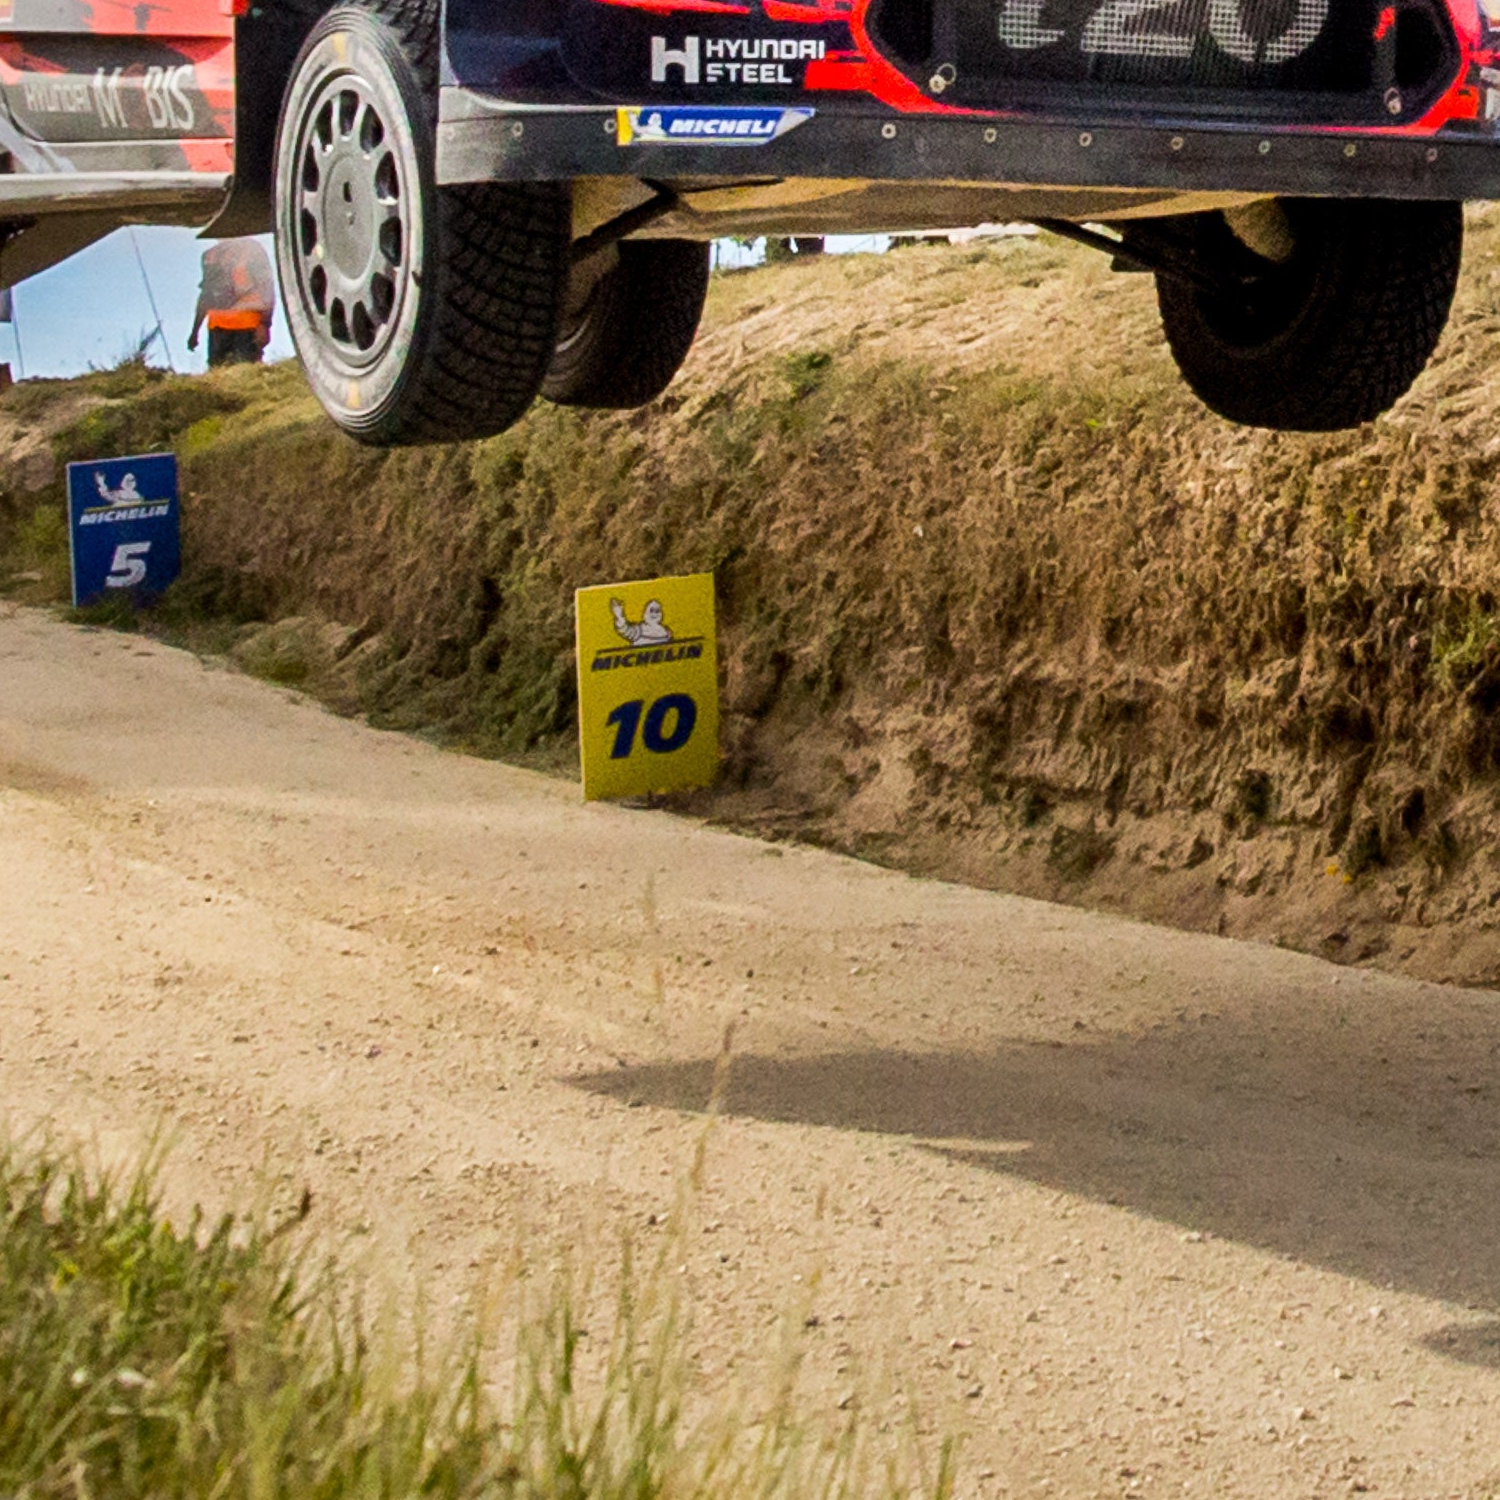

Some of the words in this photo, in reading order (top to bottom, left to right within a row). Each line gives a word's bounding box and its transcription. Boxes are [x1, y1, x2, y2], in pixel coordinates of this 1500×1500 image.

[706, 39, 826, 60] HYUNDAI
[706, 62, 793, 84] STEEL
[669, 118, 778, 135] MICHELI
[79, 504, 170, 526] MICHELIN
[105, 541, 153, 588] 5
[591, 645, 704, 672] MICHELIN
[606, 693, 698, 760] 10
